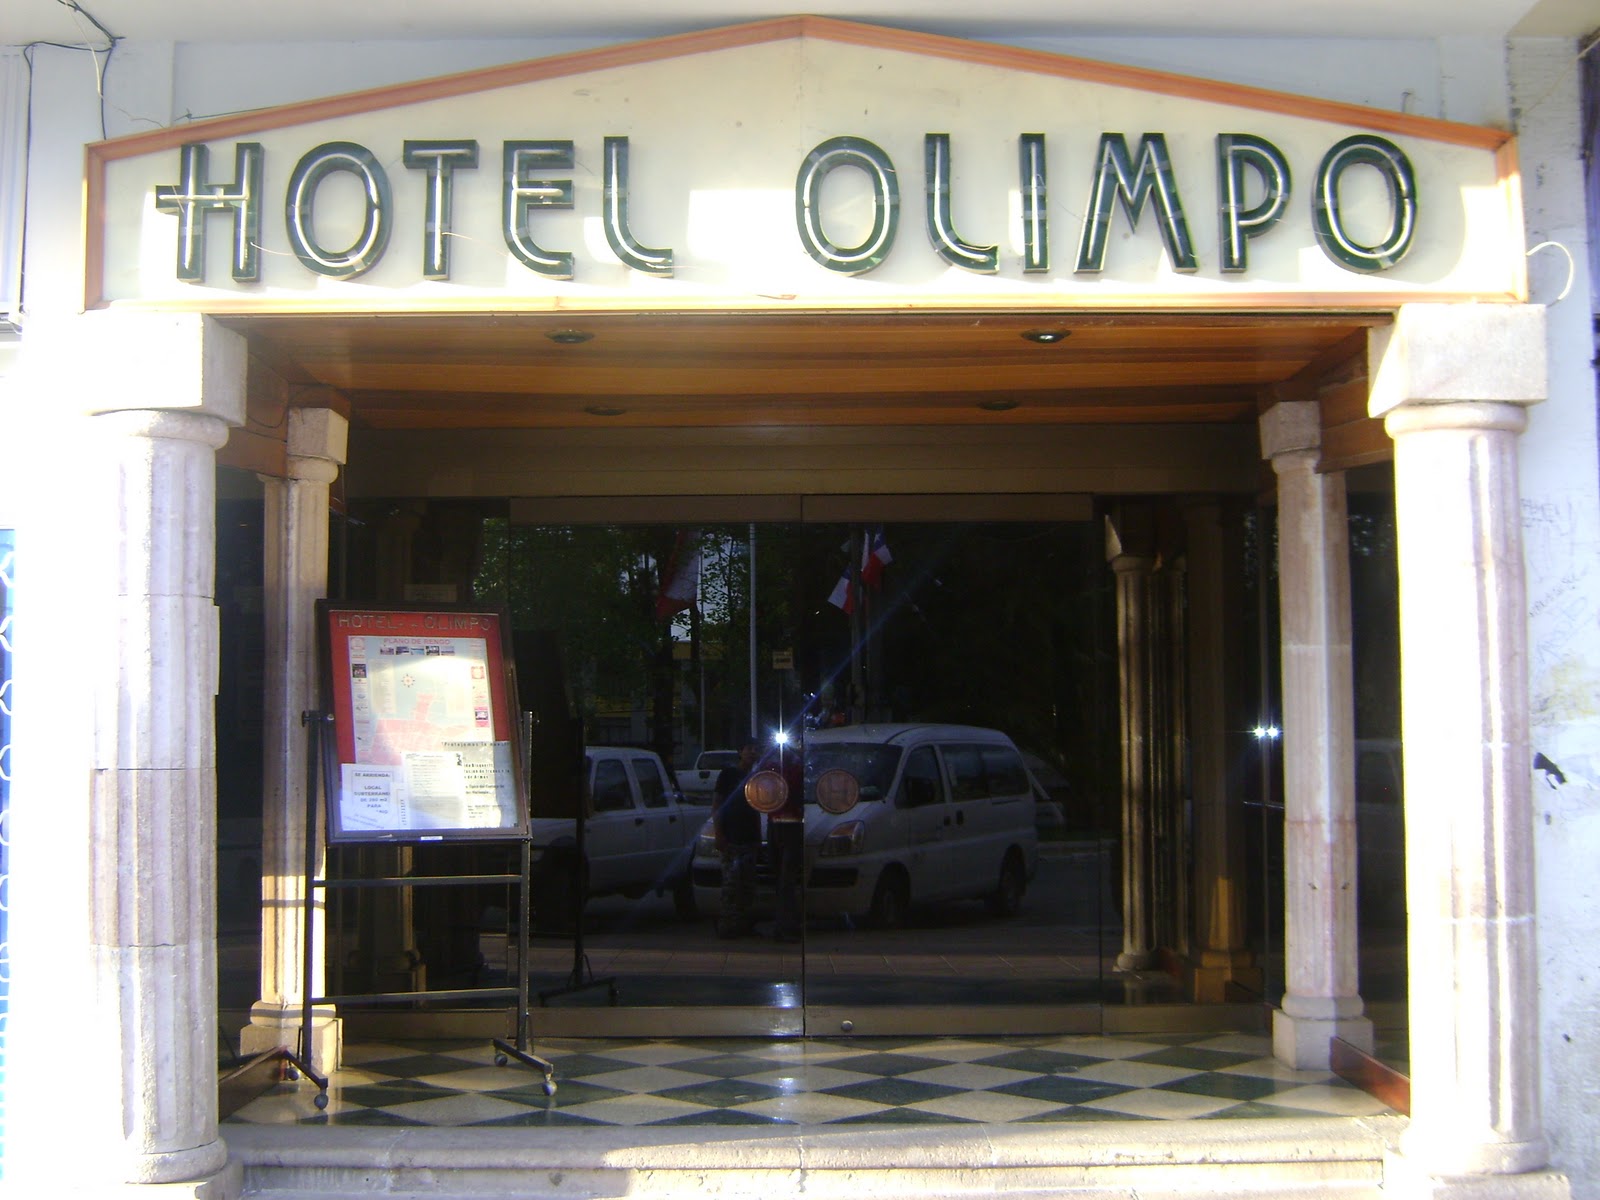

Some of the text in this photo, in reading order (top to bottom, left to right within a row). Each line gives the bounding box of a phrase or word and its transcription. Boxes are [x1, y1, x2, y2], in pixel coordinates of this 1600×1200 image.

[155, 132, 1418, 282] HOTEL OLIMPO
[338, 615, 491, 631] HOTEL OLIMPO
